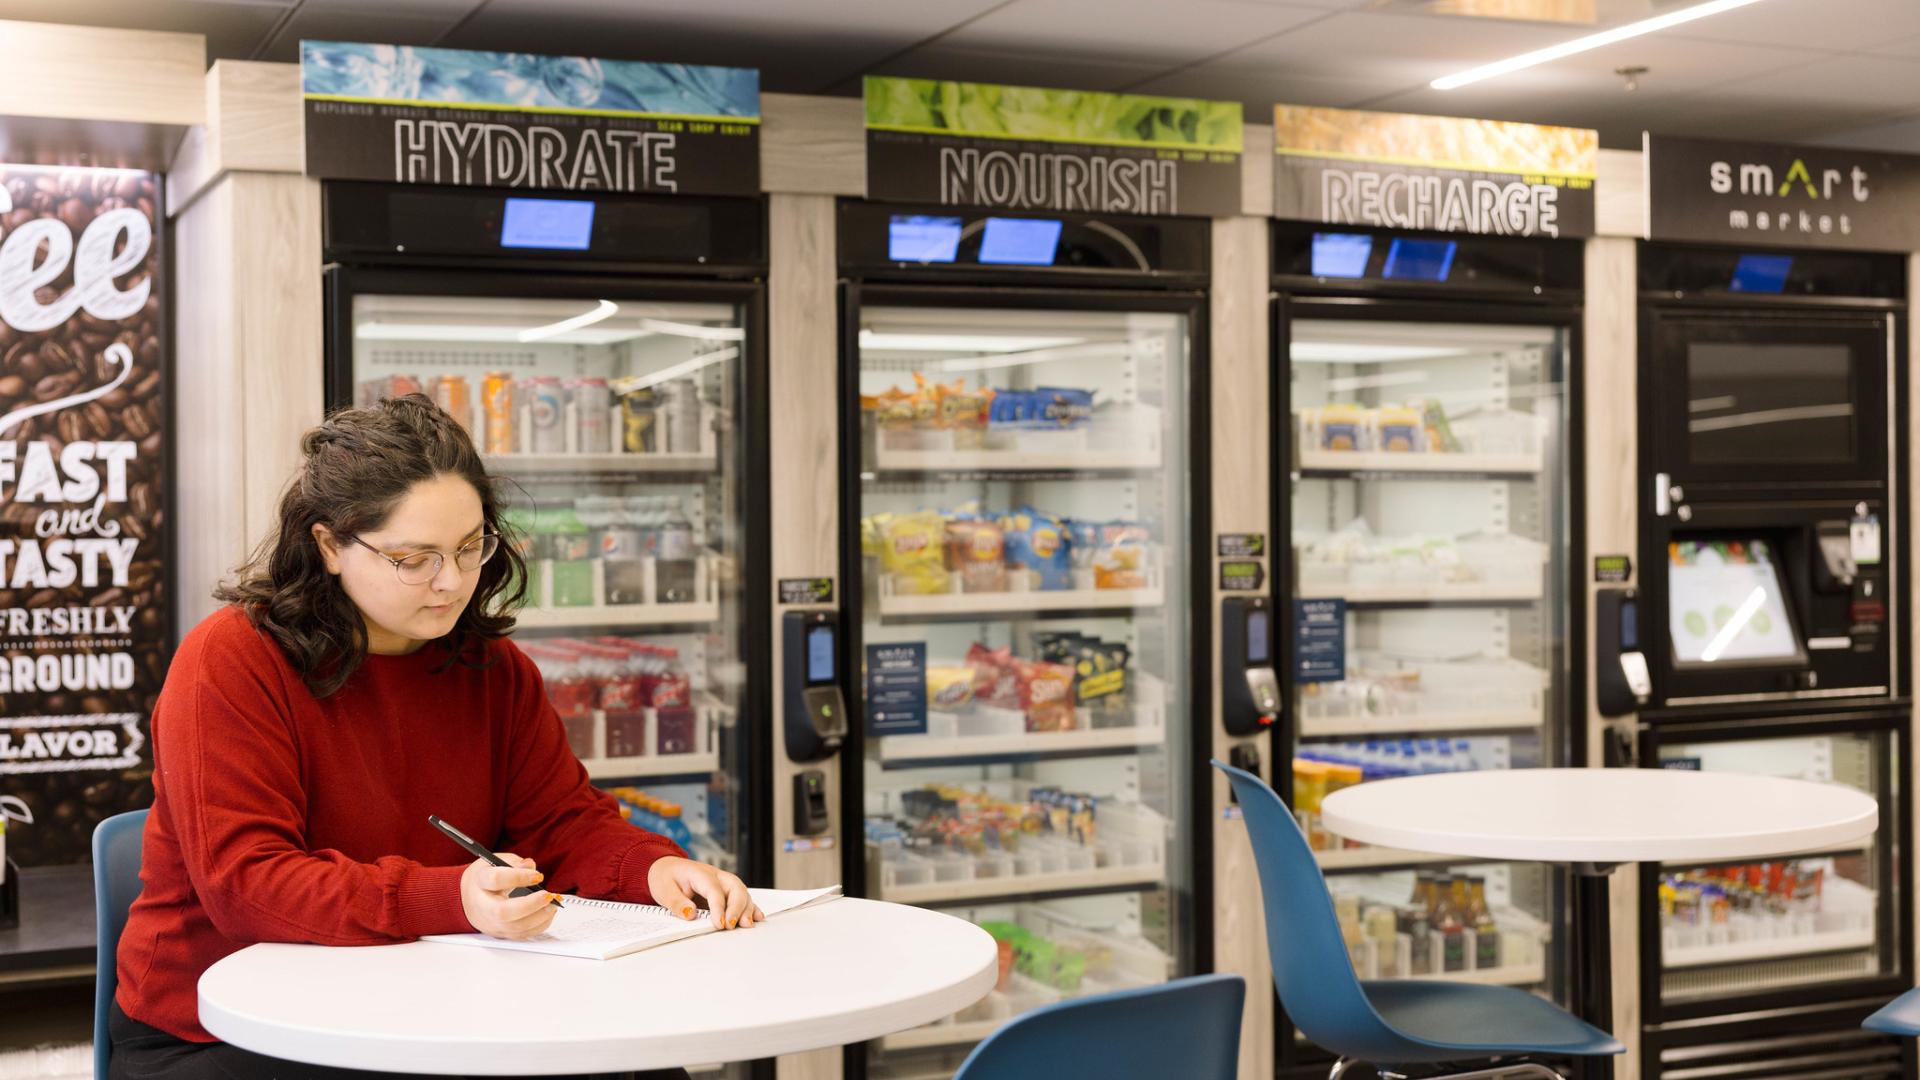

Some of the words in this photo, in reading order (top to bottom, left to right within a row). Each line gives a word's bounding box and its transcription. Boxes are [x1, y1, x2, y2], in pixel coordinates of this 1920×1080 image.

[395, 119, 677, 192] HYDRATE
[940, 147, 1177, 215] NOURISH
[1321, 169, 1559, 238] RECHARGE
[1729, 210, 1851, 235] market
[0, 183, 151, 332] ee
[35, 492, 120, 538] and
